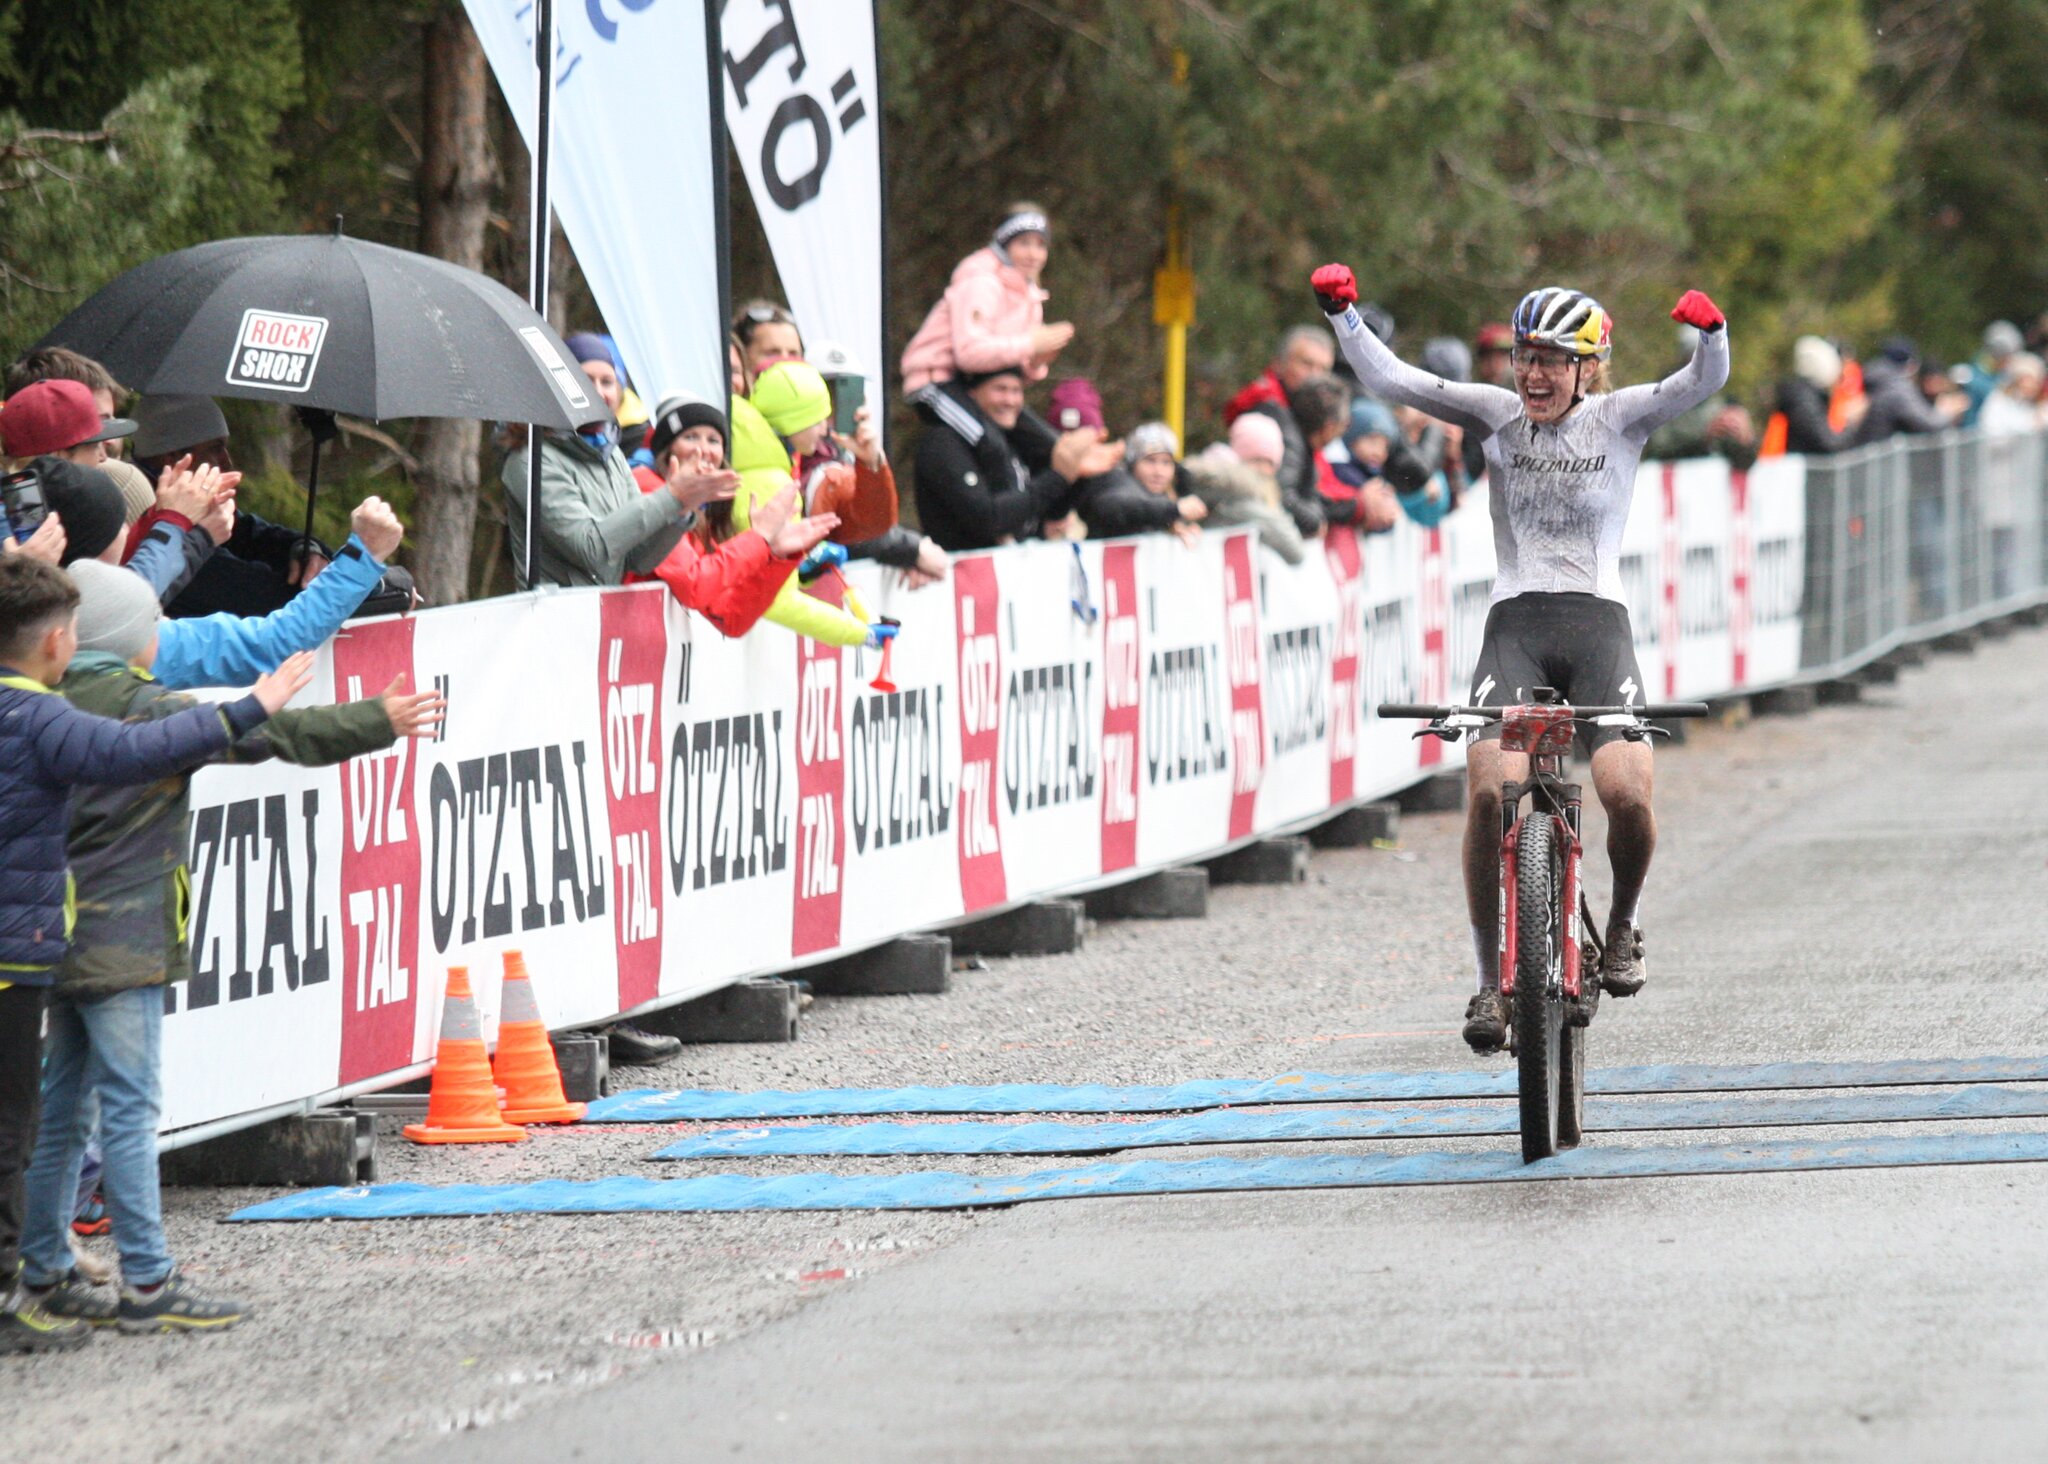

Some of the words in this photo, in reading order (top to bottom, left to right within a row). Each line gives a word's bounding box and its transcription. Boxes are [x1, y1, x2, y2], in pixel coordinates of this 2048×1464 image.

[240, 348, 307, 383] SHOX
[251, 319, 314, 349] ROCK
[1511, 454, 1606, 474] SPECIALIZED
[606, 638, 656, 801] ÖTZ
[668, 641, 788, 898] ÖTZTAL
[429, 674, 606, 955] ÖTZTAL
[801, 792, 839, 900] TAL
[163, 788, 331, 1017] ZTAL
[348, 883, 409, 1013] TAL
[615, 828, 659, 946] TAL
